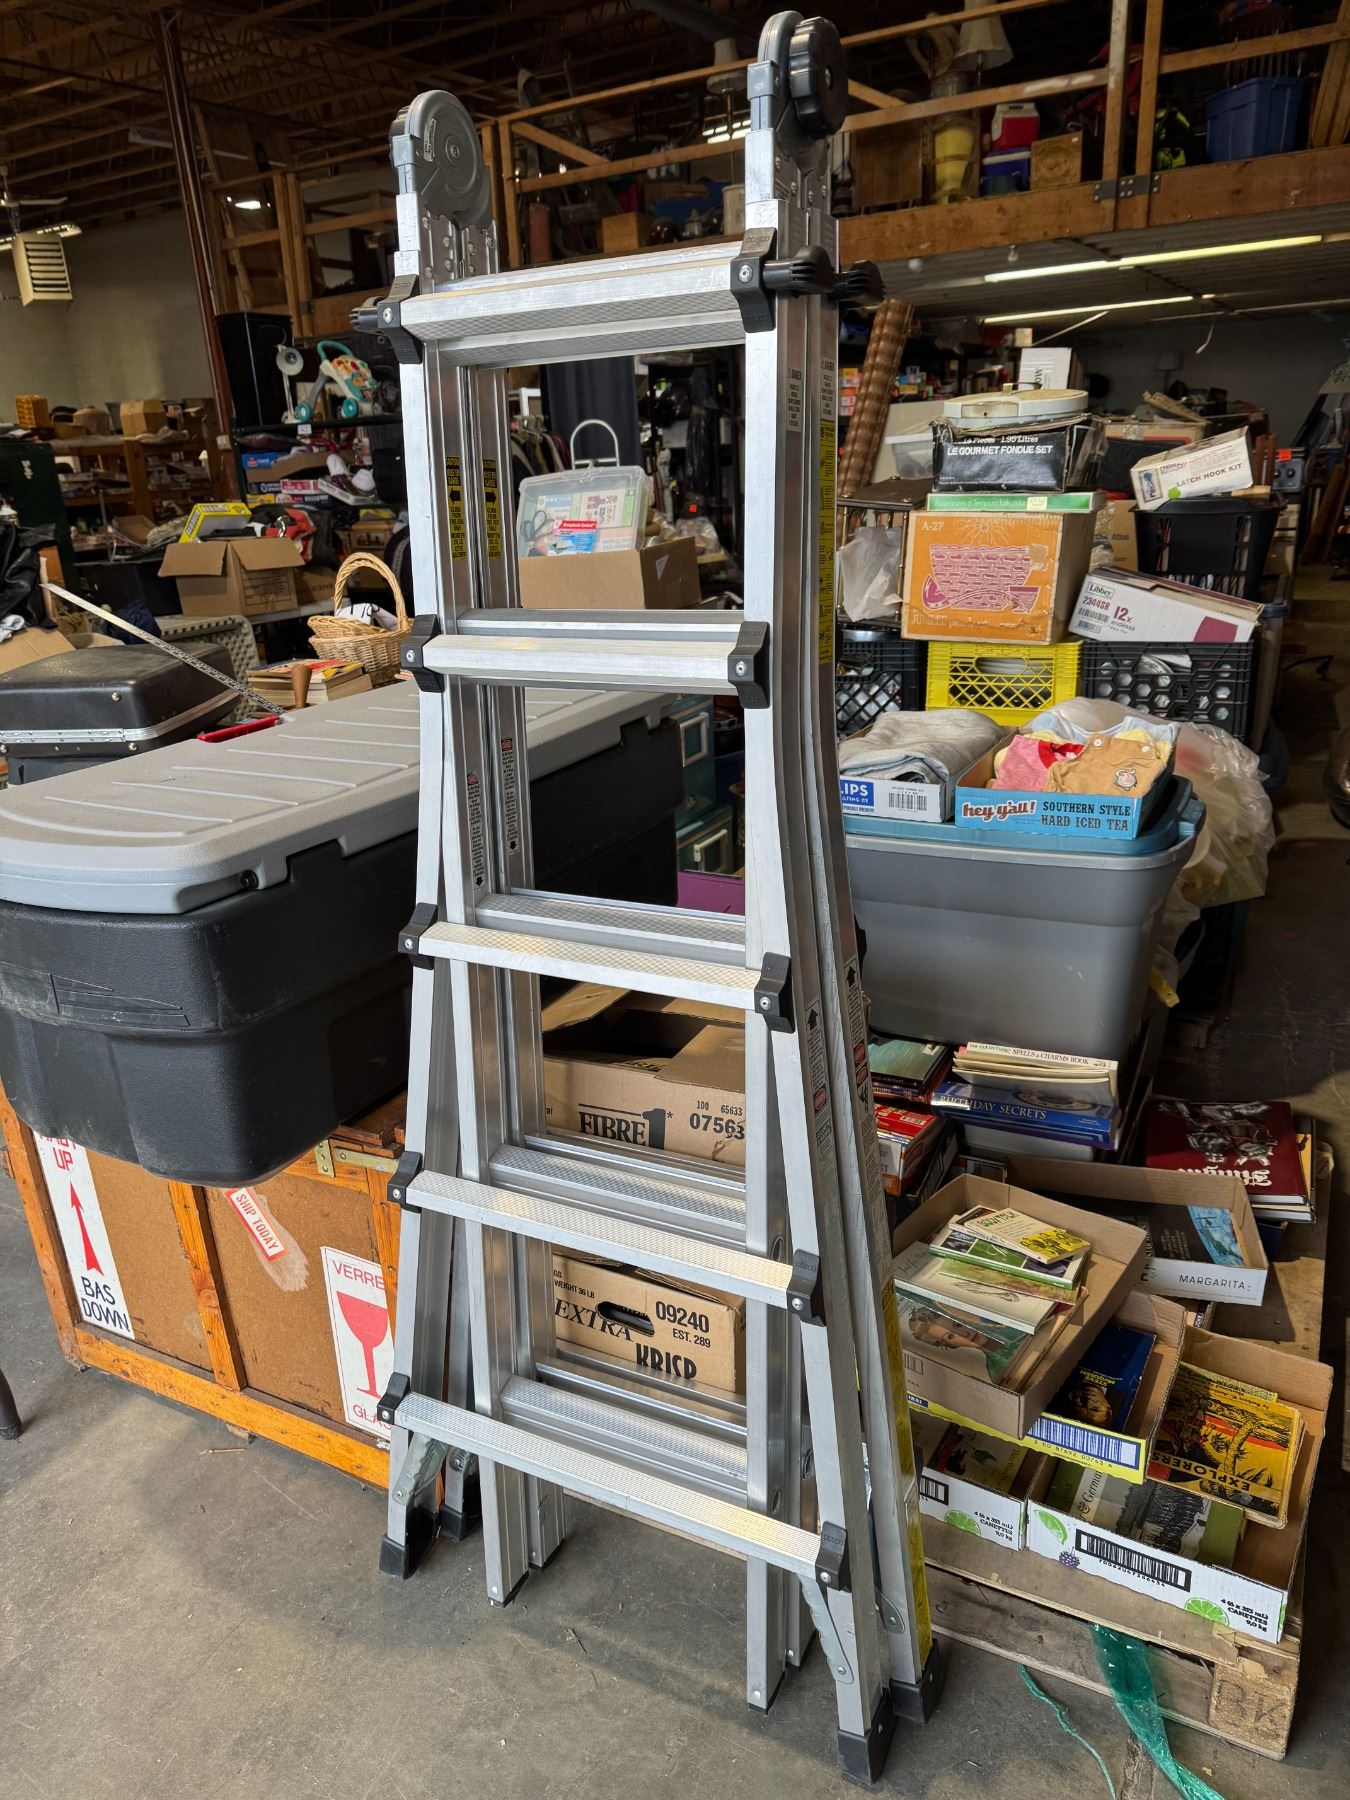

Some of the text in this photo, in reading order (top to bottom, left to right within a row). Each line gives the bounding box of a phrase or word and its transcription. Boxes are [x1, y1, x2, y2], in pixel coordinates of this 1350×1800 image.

[947, 445, 1053, 456] LE GOURMET FONDUE SET
[1176, 462, 1242, 487] LATCH HOOK KIT
[921, 521, 944, 531] A-27
[1088, 583, 1112, 597] Libbey
[1081, 596, 1110, 611] 2344SR
[962, 802, 994, 822] hey
[1043, 801, 1130, 817] SOUTHERN STYLE
[1041, 814, 1129, 831] HARD ICED TEA
[1012, 1048, 1036, 1059] SPELLS
[1040, 1052, 1070, 1062] CHARMS
[1070, 1055, 1089, 1066] BOOK
[696, 1099, 743, 1117] 100 65633
[939, 1095, 1046, 1121] BIRTHDAY SECRETS
[578, 1111, 646, 1147] FIBRE
[52, 1147, 74, 1172] UP
[235, 1193, 279, 1251] SHIP TODAY
[333, 1259, 385, 1292] VERRE
[1179, 1274, 1246, 1290] MARGARITA
[81, 1275, 116, 1306] BAS
[554, 1280, 595, 1299] WEIGHT 36 LB
[81, 1297, 130, 1333] DOWN
[555, 1298, 634, 1343] EXTRA
[655, 1300, 710, 1334] 09240
[672, 1327, 712, 1349] EST. 289
[635, 1342, 697, 1380] KRISP
[1152, 1452, 1250, 1491] EXPLORERS
[980, 1518, 1013, 1536] CANETTES
[1227, 1606, 1268, 1627] CANETTES
[1257, 1623, 1268, 1633] kg
